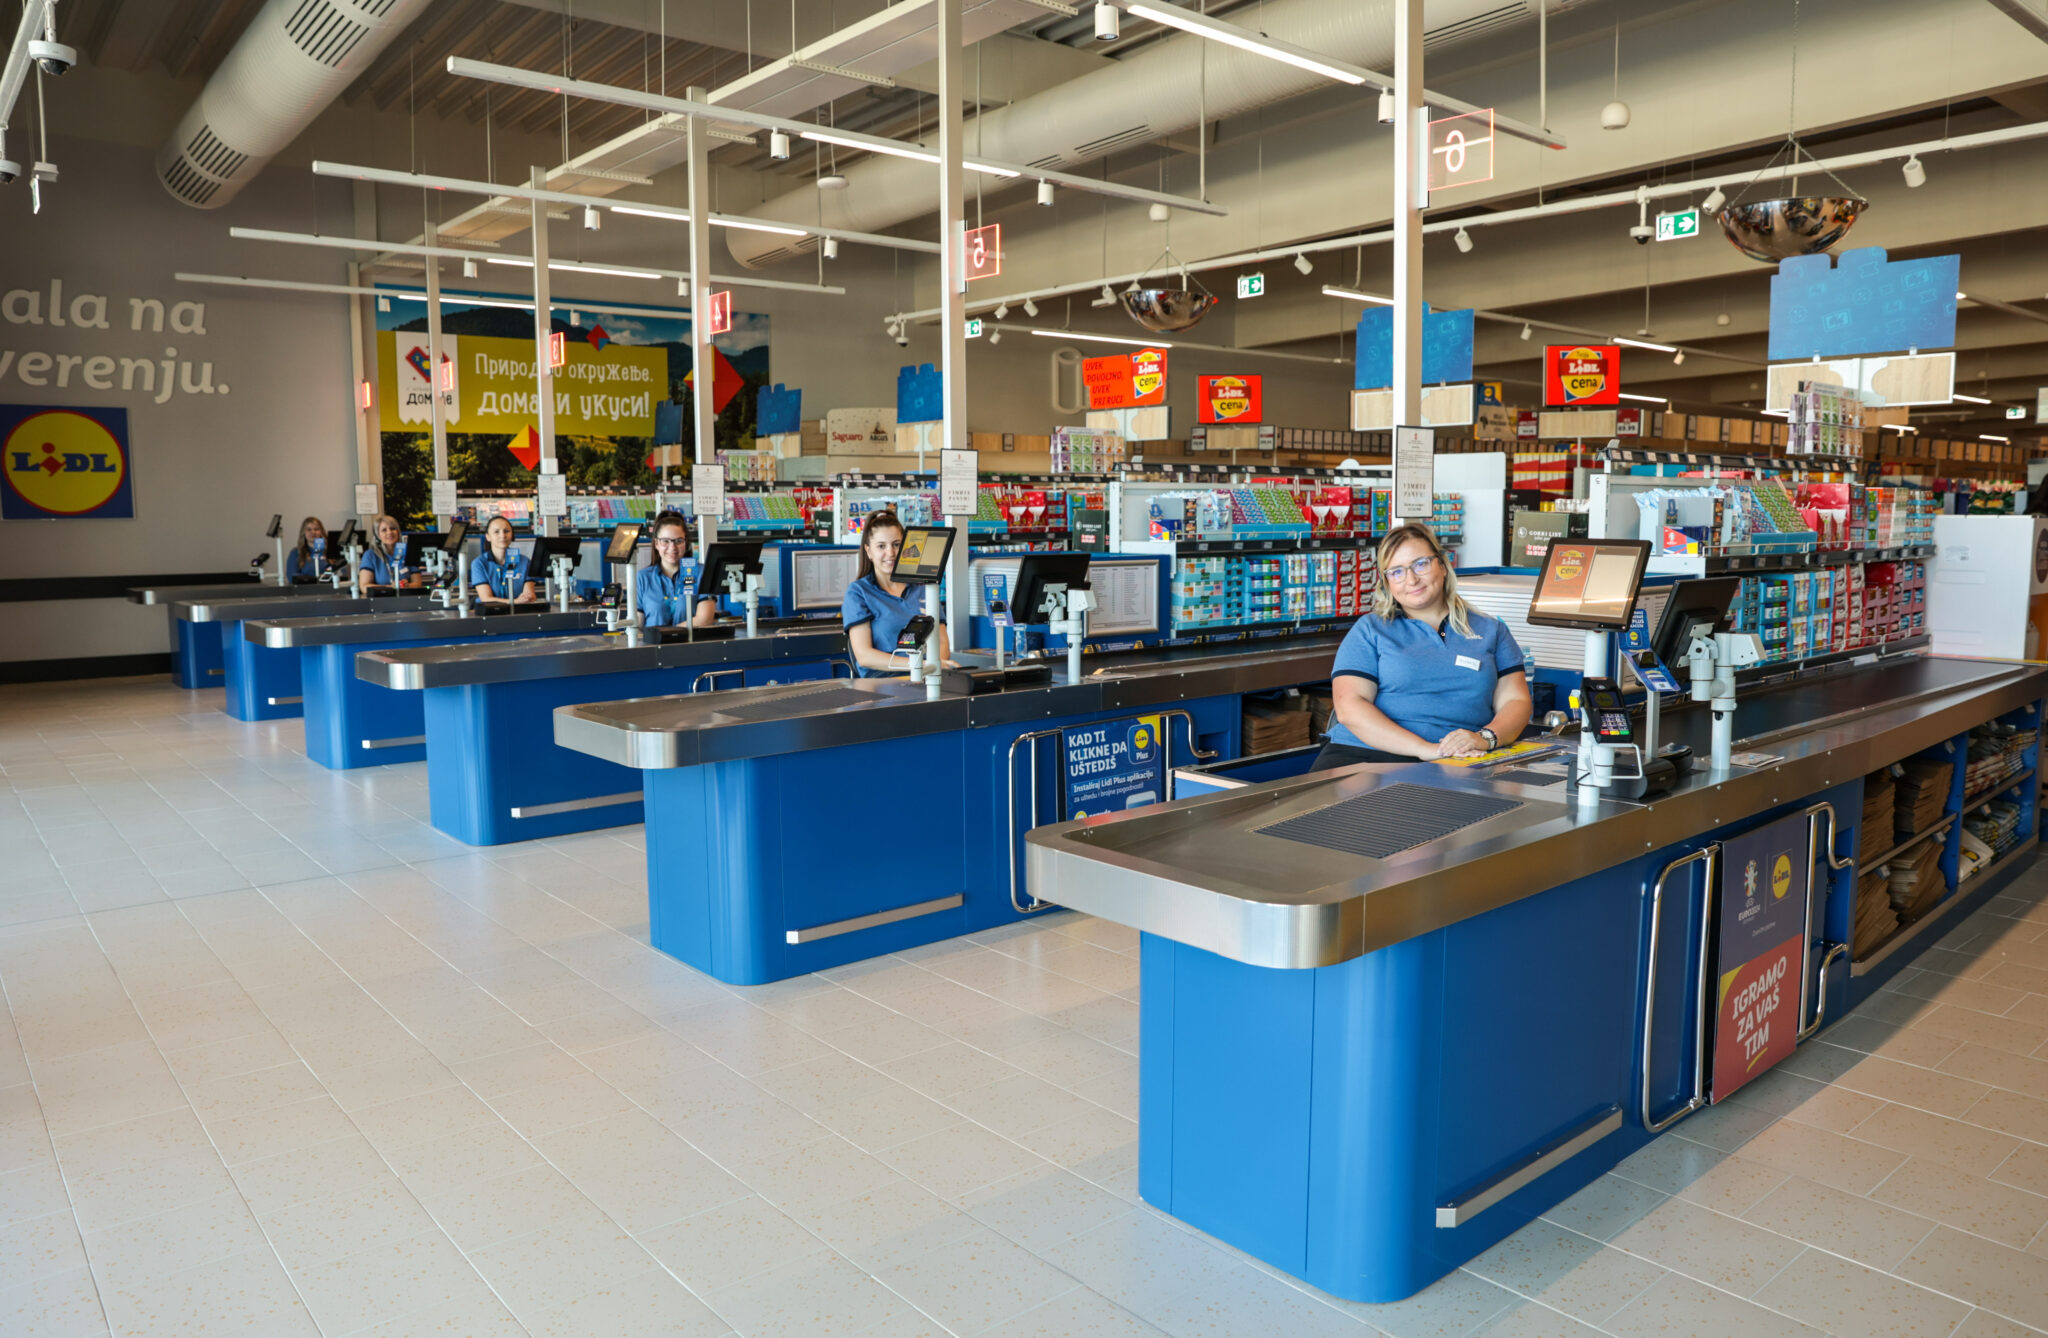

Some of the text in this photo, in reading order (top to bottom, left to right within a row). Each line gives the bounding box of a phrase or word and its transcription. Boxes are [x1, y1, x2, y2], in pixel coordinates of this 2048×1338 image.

[129, 297, 208, 335] na
[475, 353, 563, 382] Природо
[1139, 376, 1157, 387] cena
[1571, 378, 1598, 390] cena
[477, 391, 650, 421] Домаи укуси!
[1220, 401, 1243, 411] cena
[1068, 730, 1106, 748] KAD TI
[1070, 741, 1128, 762] KLIKNE DA
[1136, 752, 1149, 760] Plus
[1070, 756, 1116, 777] UŠTEDIŠ
[1074, 770, 1154, 793] Instaliraj Lidl Plus aplikaciju
[1732, 955, 1787, 1021] IGRAMO
[1736, 982, 1780, 1043] ZA VAŠ
[1744, 1021, 1770, 1061] TIM
